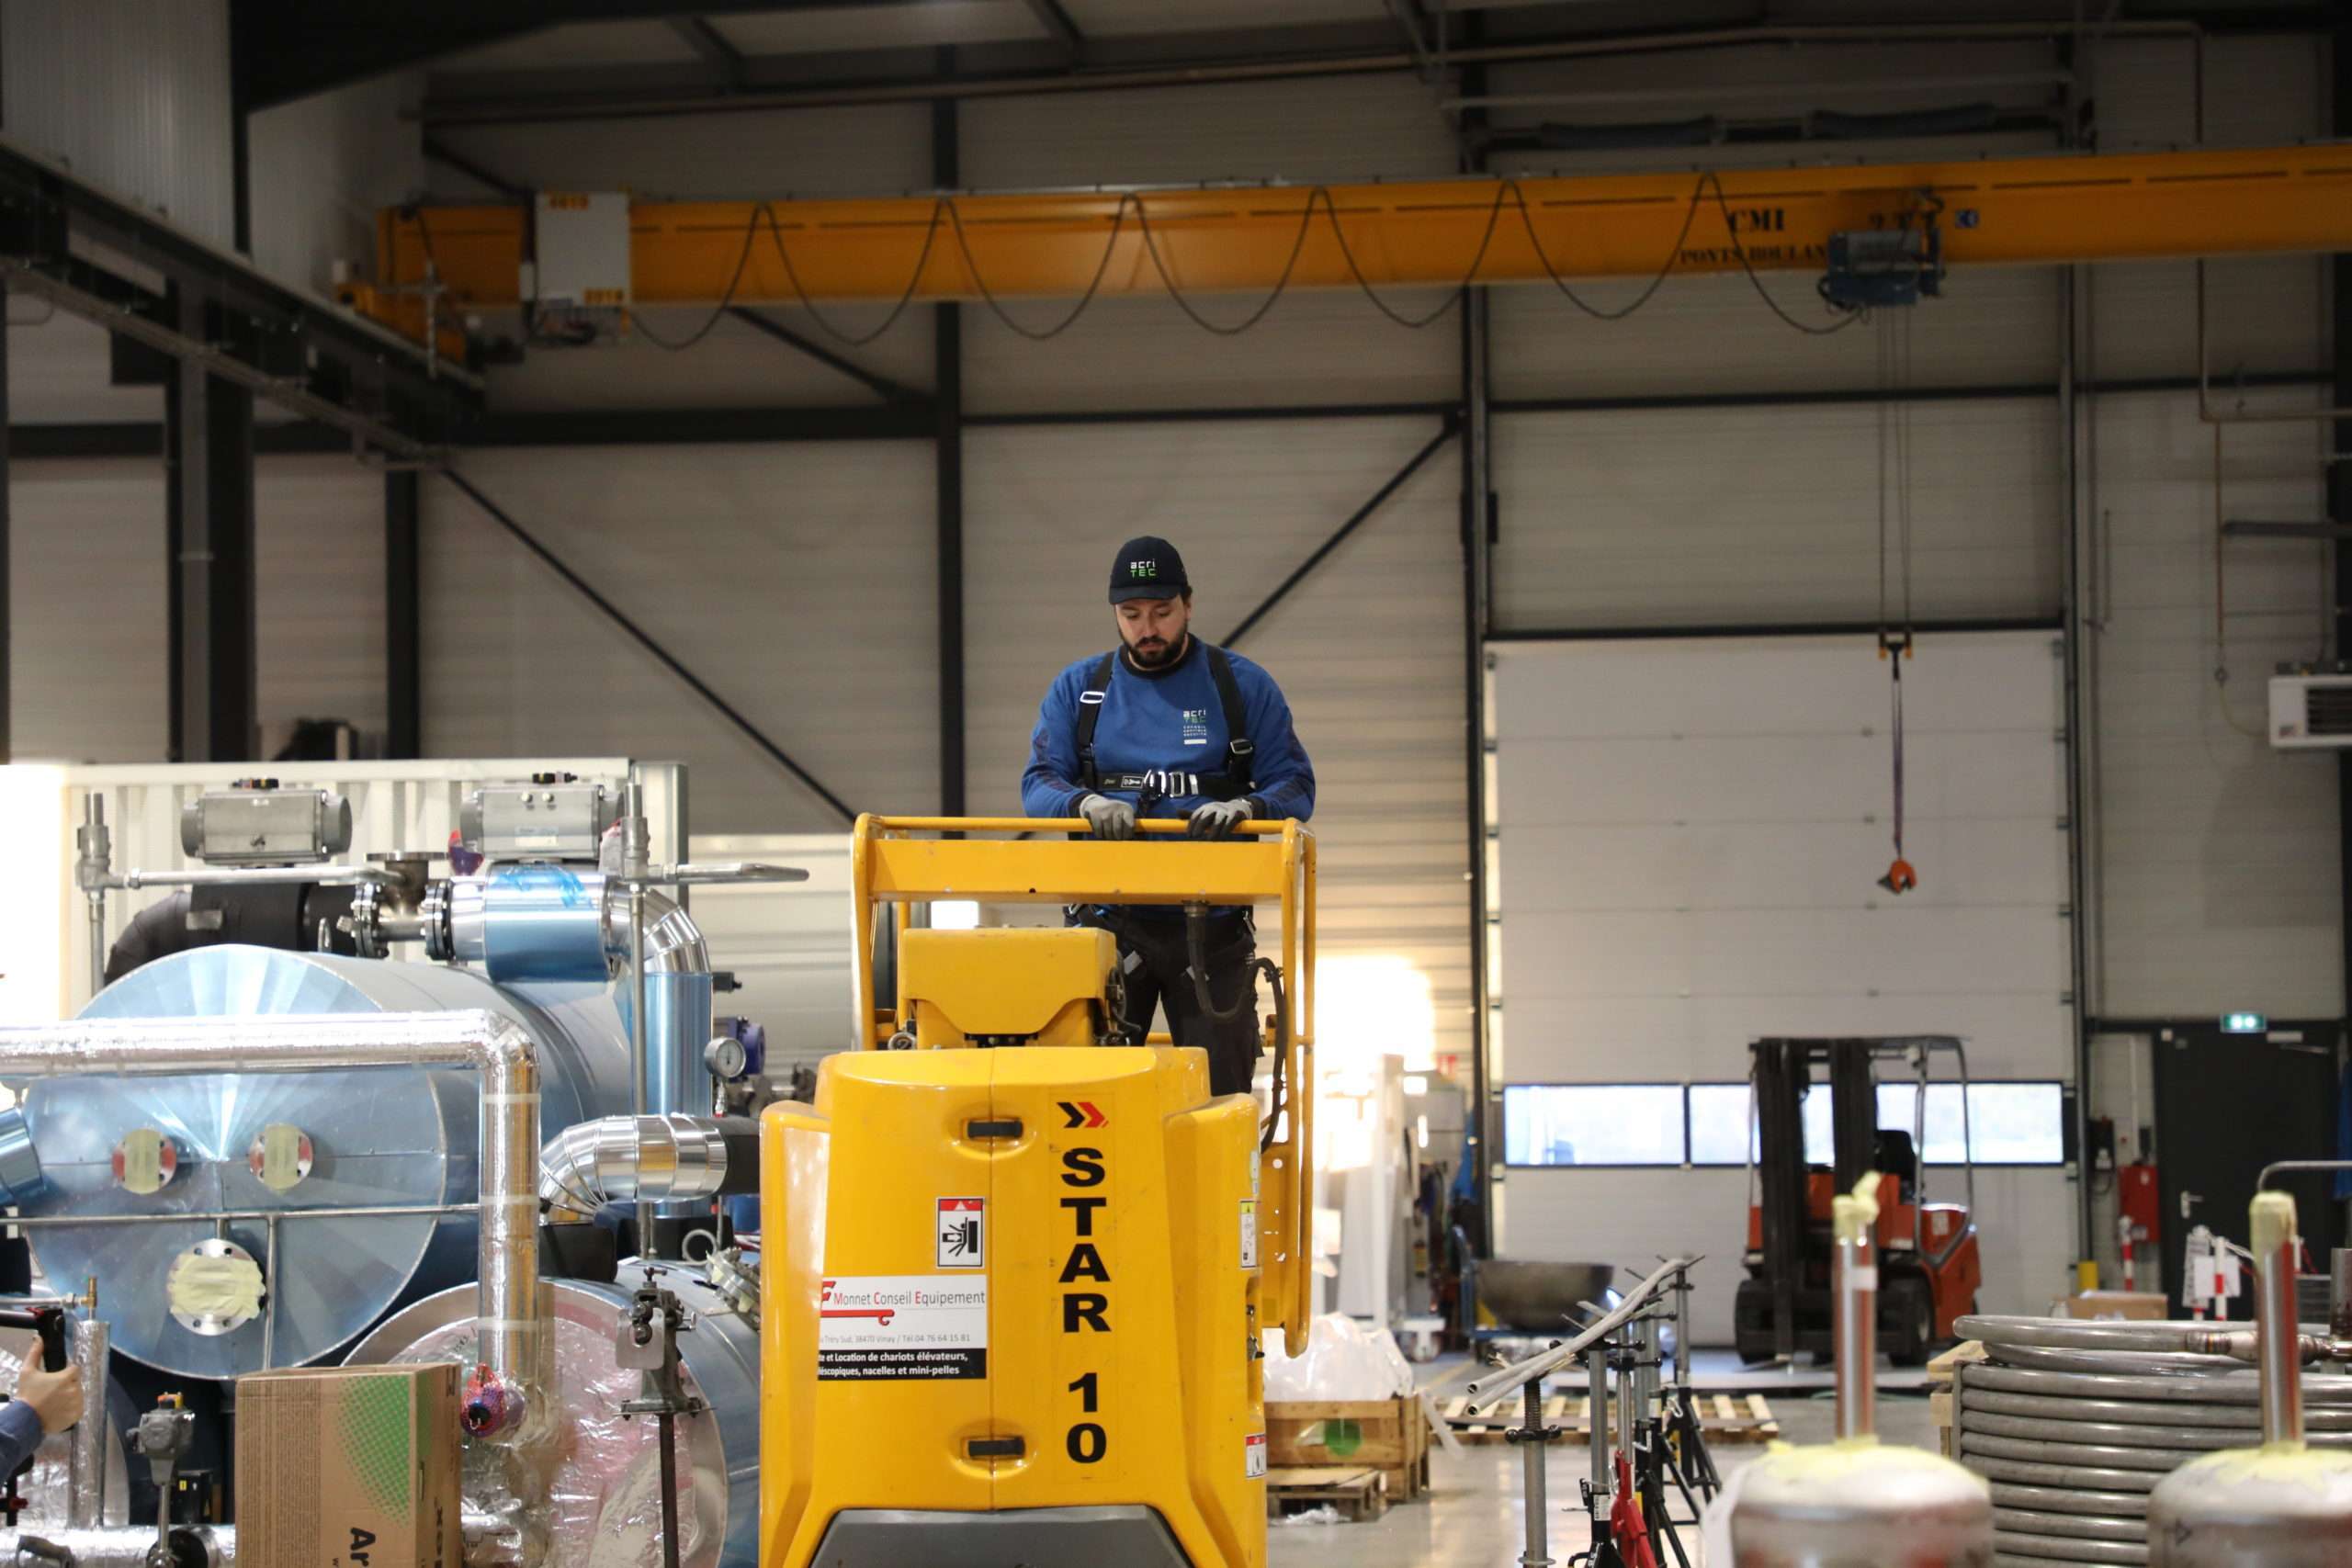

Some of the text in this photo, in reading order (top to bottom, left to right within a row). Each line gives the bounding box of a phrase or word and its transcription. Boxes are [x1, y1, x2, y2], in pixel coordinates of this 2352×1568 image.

[1728, 209, 1785, 232] CMI
[1130, 558, 1156, 570] acri
[1130, 569, 1157, 578] TEC
[833, 1292, 871, 1305] Monnet
[874, 1291, 911, 1305] Conseil
[915, 1290, 986, 1306] Equipement
[1058, 1146, 1112, 1463] STAR 10
[834, 1352, 866, 1361] Location
[868, 1352, 878, 1361] de
[880, 1352, 915, 1361] chariots
[917, 1351, 968, 1362] élévateurs,
[863, 1366, 896, 1375] nacelles
[898, 1366, 907, 1374] et
[909, 1365, 960, 1376] mini-pelles
